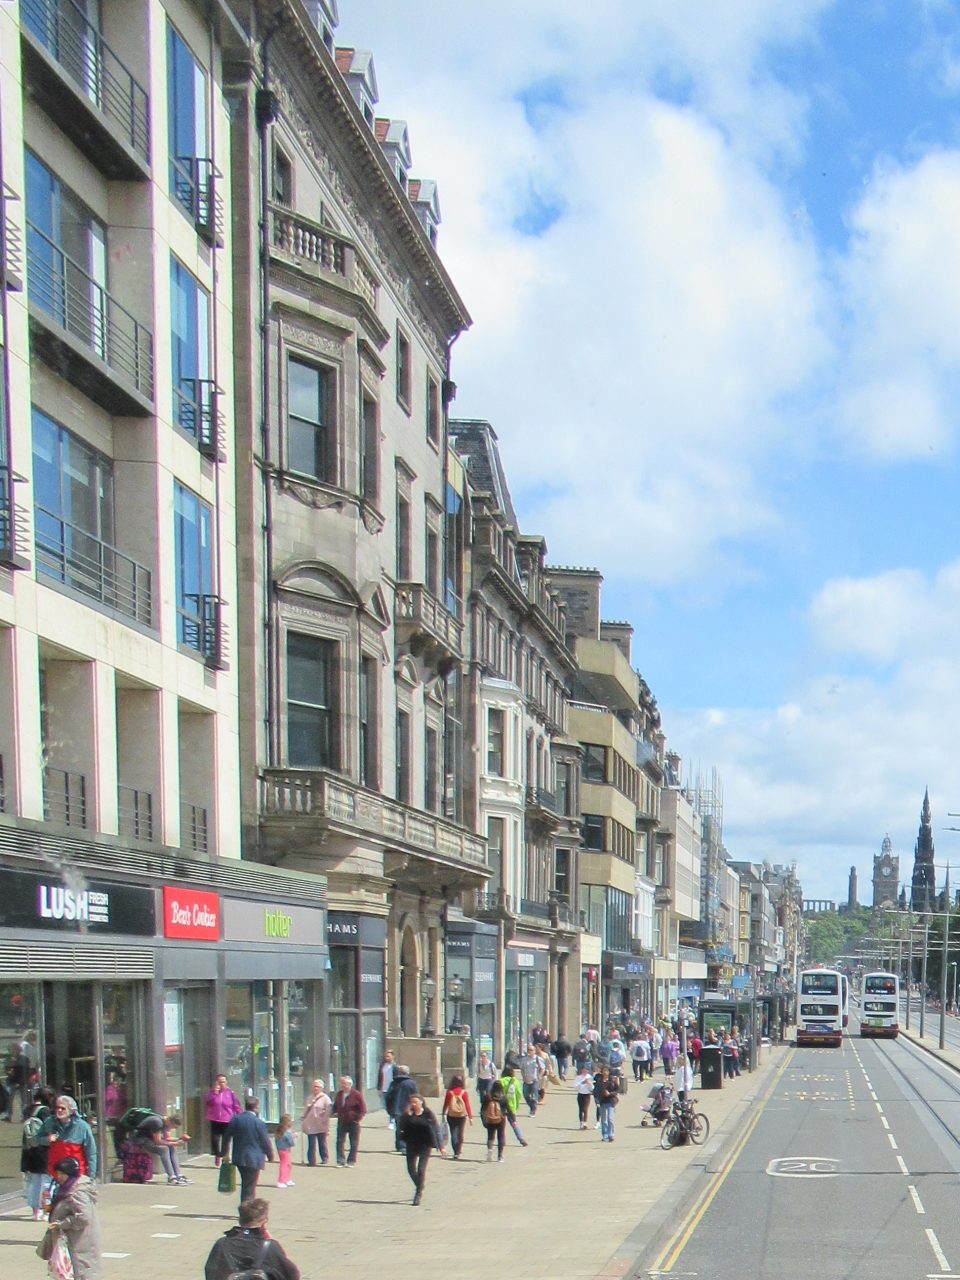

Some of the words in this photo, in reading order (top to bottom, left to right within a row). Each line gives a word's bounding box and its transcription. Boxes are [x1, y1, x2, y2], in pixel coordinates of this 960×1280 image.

[39, 885, 88, 921] LUSH
[171, 901, 191, 925] Ben's
[192, 903, 216, 928] Cookies
[264, 908, 292, 938] hotter
